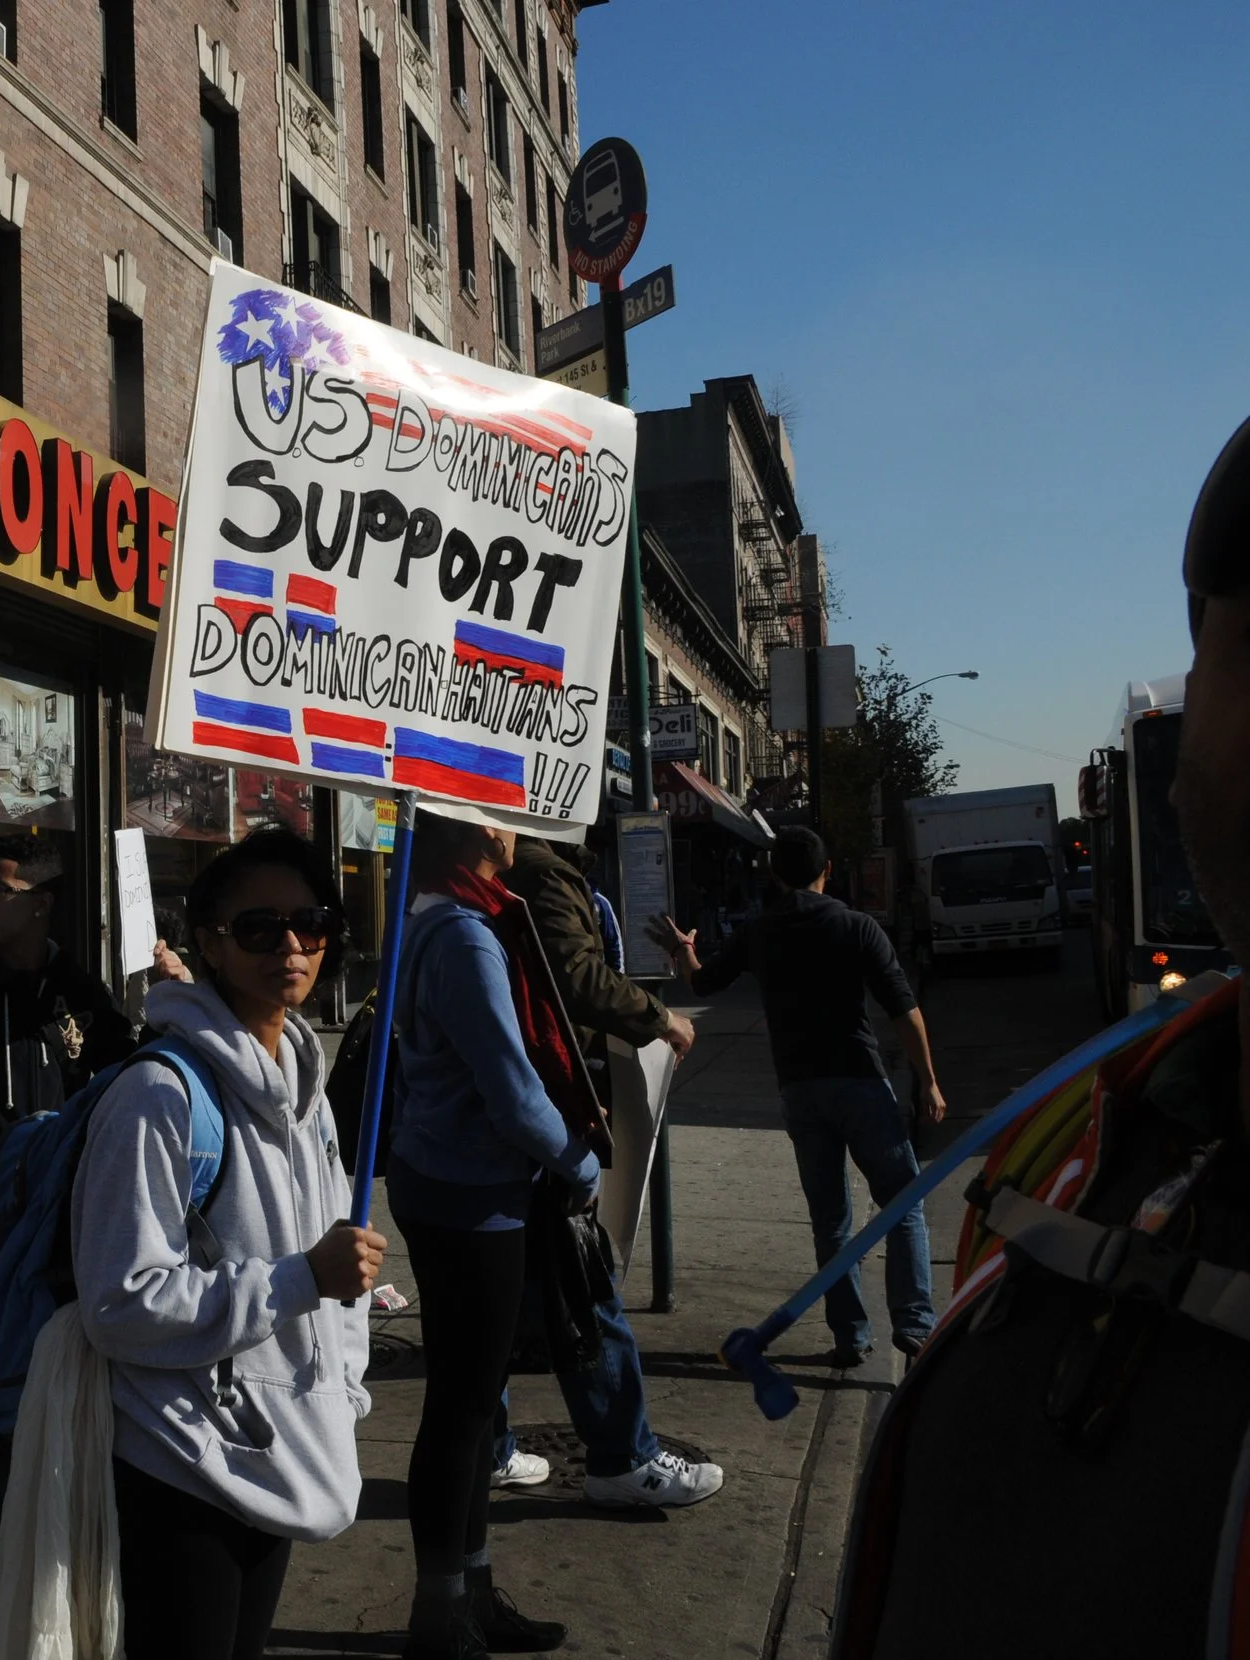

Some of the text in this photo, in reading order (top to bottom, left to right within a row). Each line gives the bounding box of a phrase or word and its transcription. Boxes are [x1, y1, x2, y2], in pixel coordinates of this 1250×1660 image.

[573, 250, 589, 273] NO
[591, 220, 639, 277] STANDING
[623, 276, 667, 323] Bx19
[540, 320, 581, 349] Riverbank
[541, 346, 560, 364] Park
[564, 366, 580, 384] 145
[580, 362, 590, 377] St
[219, 459, 583, 634] SUPPORT
[649, 713, 693, 736] Deli
